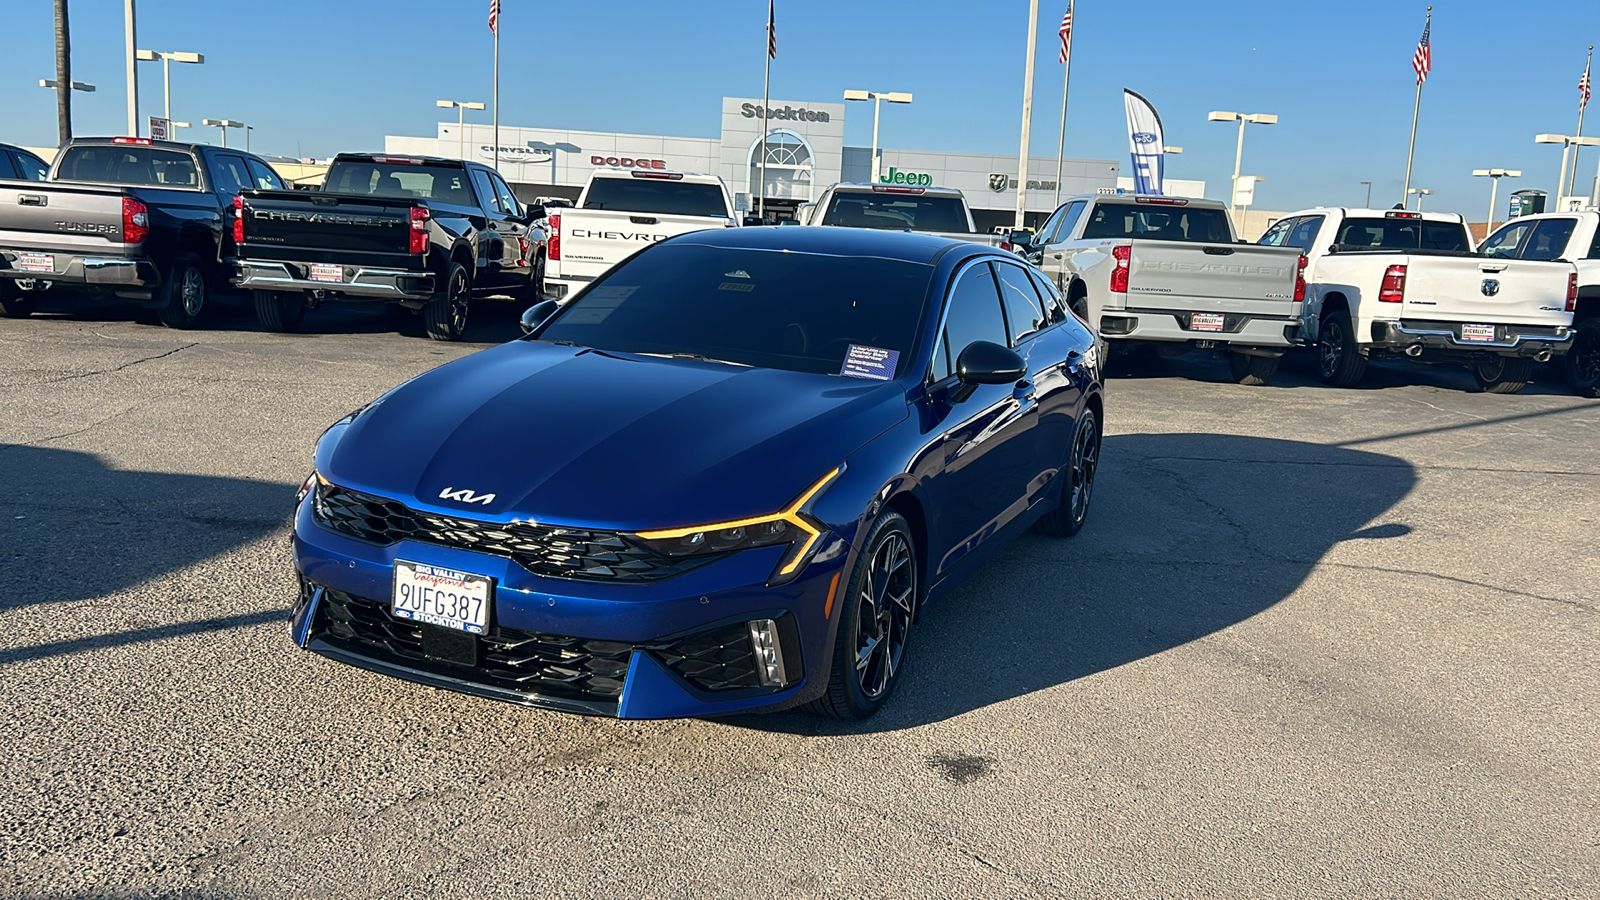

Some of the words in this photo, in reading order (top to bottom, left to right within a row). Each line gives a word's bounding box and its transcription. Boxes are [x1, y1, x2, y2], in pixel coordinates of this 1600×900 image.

[741, 103, 830, 123] Stockton
[481, 145, 552, 156] CHRYSLER
[591, 156, 666, 170] DODGE
[880, 166, 932, 186] Jeep
[1008, 179, 1061, 191] RAM
[55, 221, 119, 234] TUNDRA
[253, 210, 400, 228] CHEVROLET
[1141, 261, 1287, 276] CHEVROLET
[438, 487, 496, 505] KIA
[413, 571, 473, 591] California
[415, 564, 432, 575] BIG
[433, 567, 467, 581] VALLEY
[400, 583, 483, 624] 9UFG387
[412, 611, 465, 630] STOCKTON
